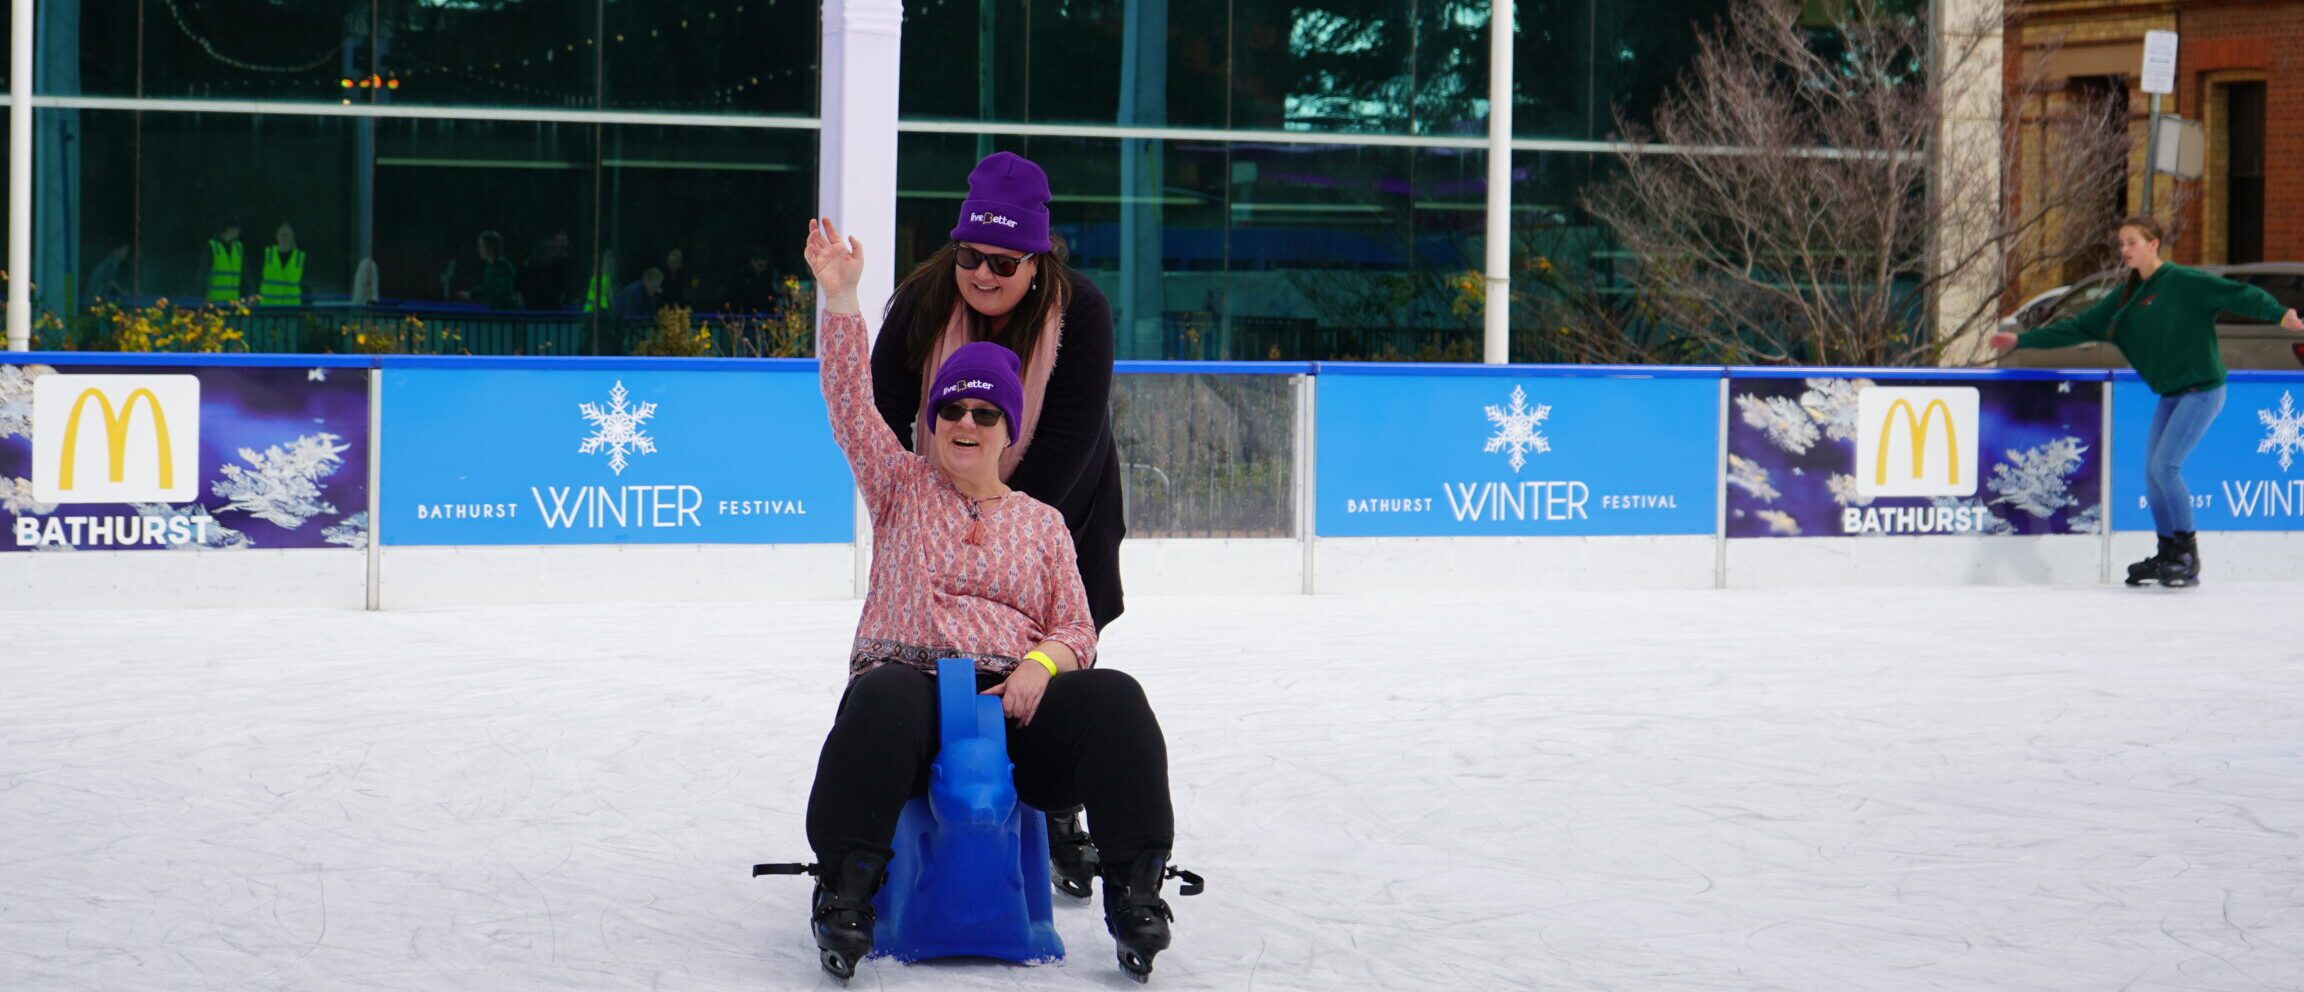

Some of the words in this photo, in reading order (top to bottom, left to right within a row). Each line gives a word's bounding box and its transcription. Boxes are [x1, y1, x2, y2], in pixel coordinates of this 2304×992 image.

[417, 503, 518, 519] BATHURST
[531, 485, 702, 528] WINTER
[719, 500, 807, 515] FESTIVAL
[1348, 498, 1433, 513] BATHURST
[1444, 481, 1589, 521] WINTER
[1603, 494, 1677, 509] FESTIVAL
[16, 516, 212, 546] BATHURST
[1843, 507, 1988, 533] BATHURST
